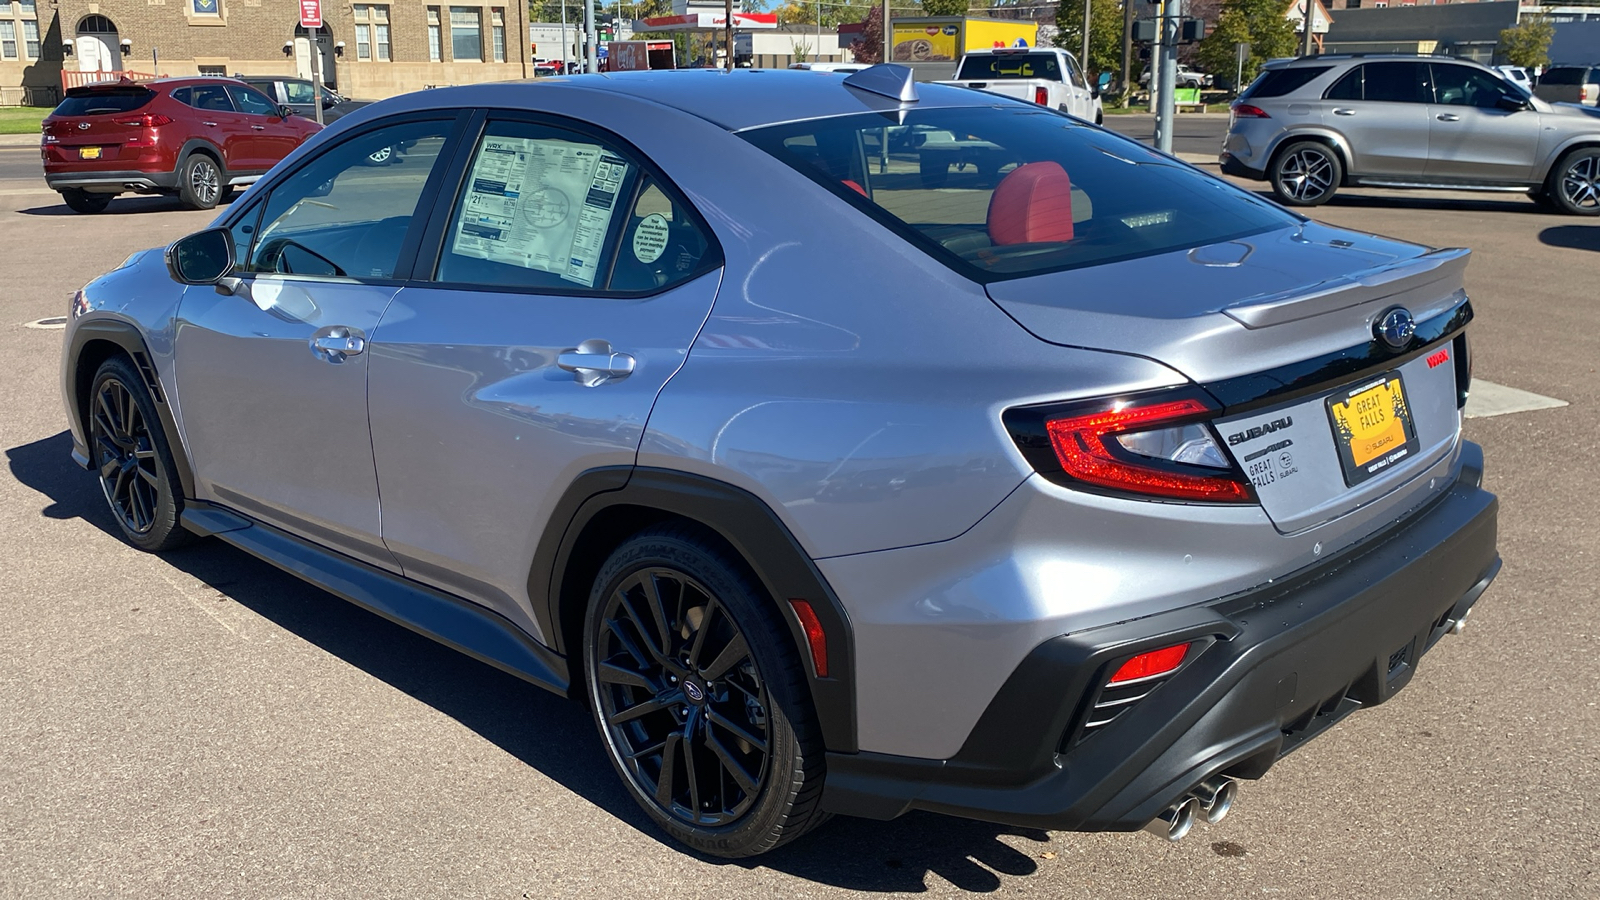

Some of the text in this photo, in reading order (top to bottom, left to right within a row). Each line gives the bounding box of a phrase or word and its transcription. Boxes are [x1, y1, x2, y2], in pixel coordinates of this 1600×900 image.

[473, 195, 481, 204] 21
[1357, 394, 1381, 414] GREAT
[1360, 408, 1385, 430] FALLS
[1228, 416, 1293, 446] SUBARU
[1265, 439, 1293, 453] AWD
[1371, 435, 1394, 450] SUBARU
[1249, 459, 1272, 476] GREAT
[1280, 466, 1298, 479] SUBARU
[1252, 471, 1275, 488] FALLS
